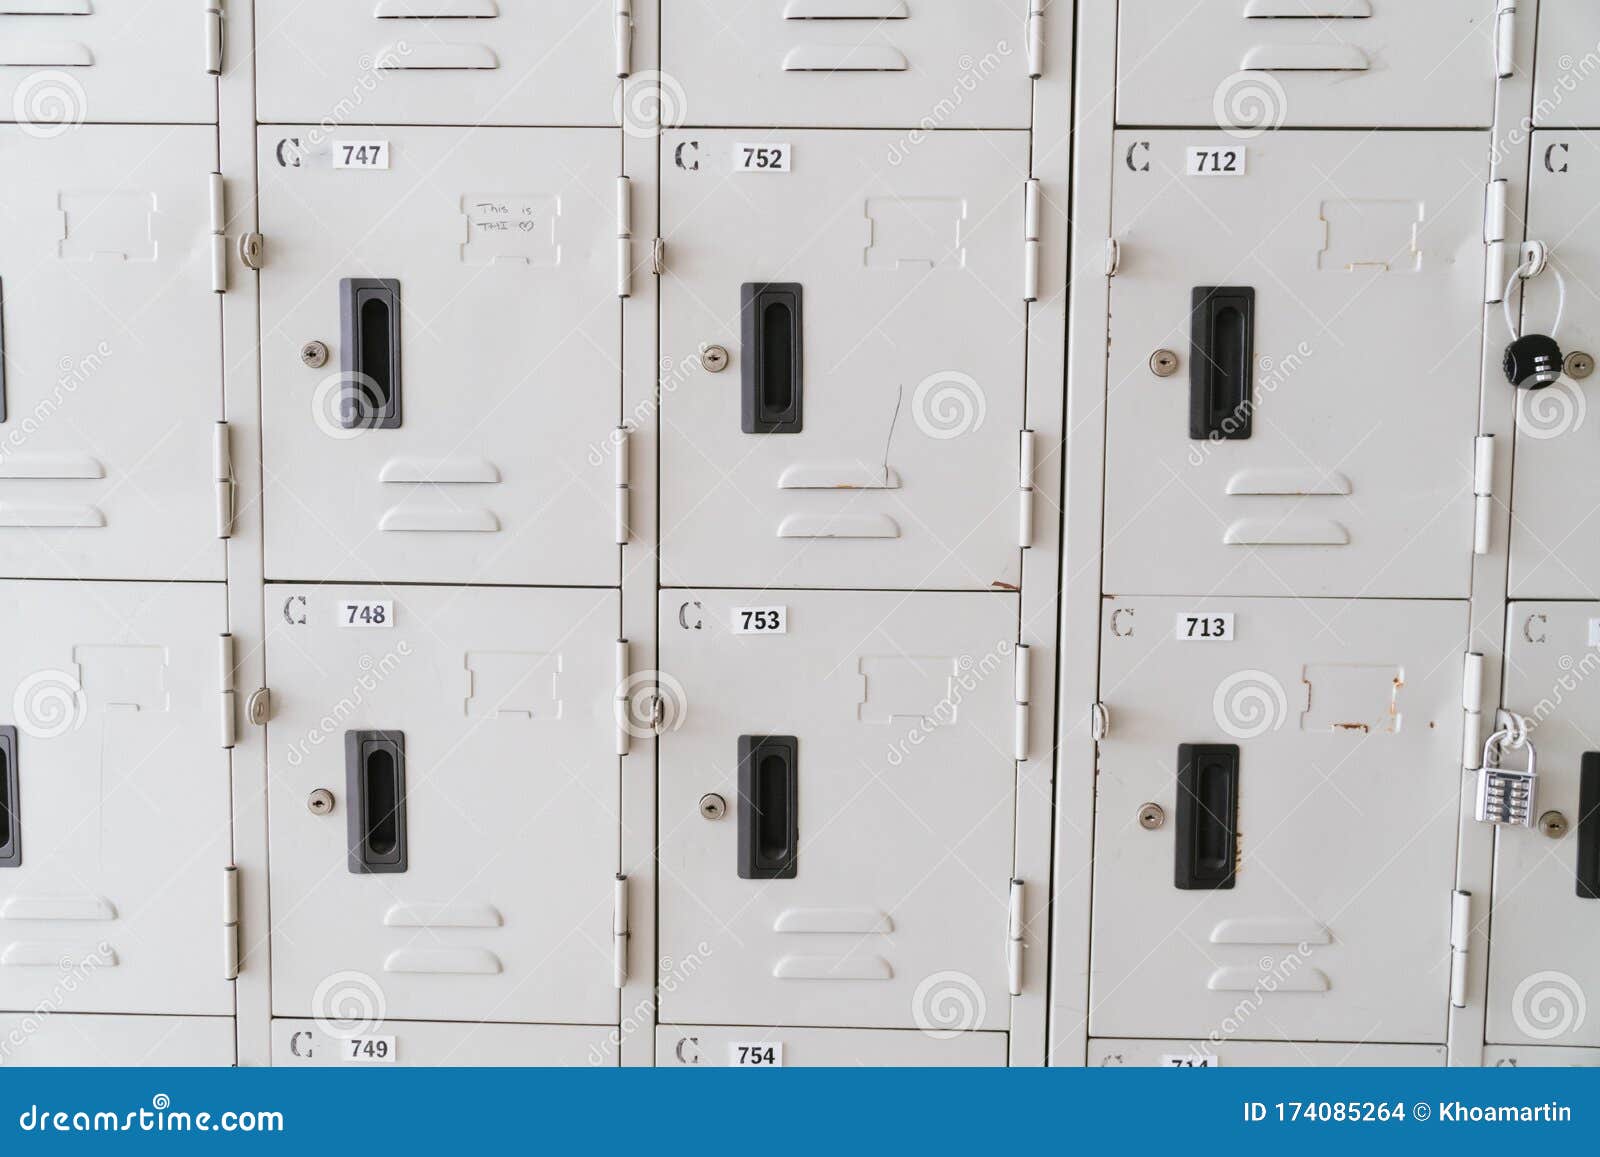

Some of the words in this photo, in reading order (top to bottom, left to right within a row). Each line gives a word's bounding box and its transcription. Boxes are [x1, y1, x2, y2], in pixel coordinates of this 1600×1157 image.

[276, 138, 301, 168] C
[342, 146, 381, 165] 747
[674, 141, 699, 171] C
[742, 148, 783, 169] 752
[1125, 141, 1150, 172] C
[1195, 151, 1236, 172] 712
[1544, 143, 1569, 173] C
[476, 202, 509, 214] This
[521, 206, 532, 216] is
[283, 595, 307, 625] C
[346, 605, 386, 624] 748
[741, 610, 781, 630] 753
[1110, 608, 1135, 637] C
[1185, 617, 1226, 638] 713
[1523, 613, 1547, 643] C
[290, 1031, 313, 1059] C
[350, 1039, 389, 1058] 749
[675, 1037, 699, 1064] C
[737, 1046, 777, 1065] 754
